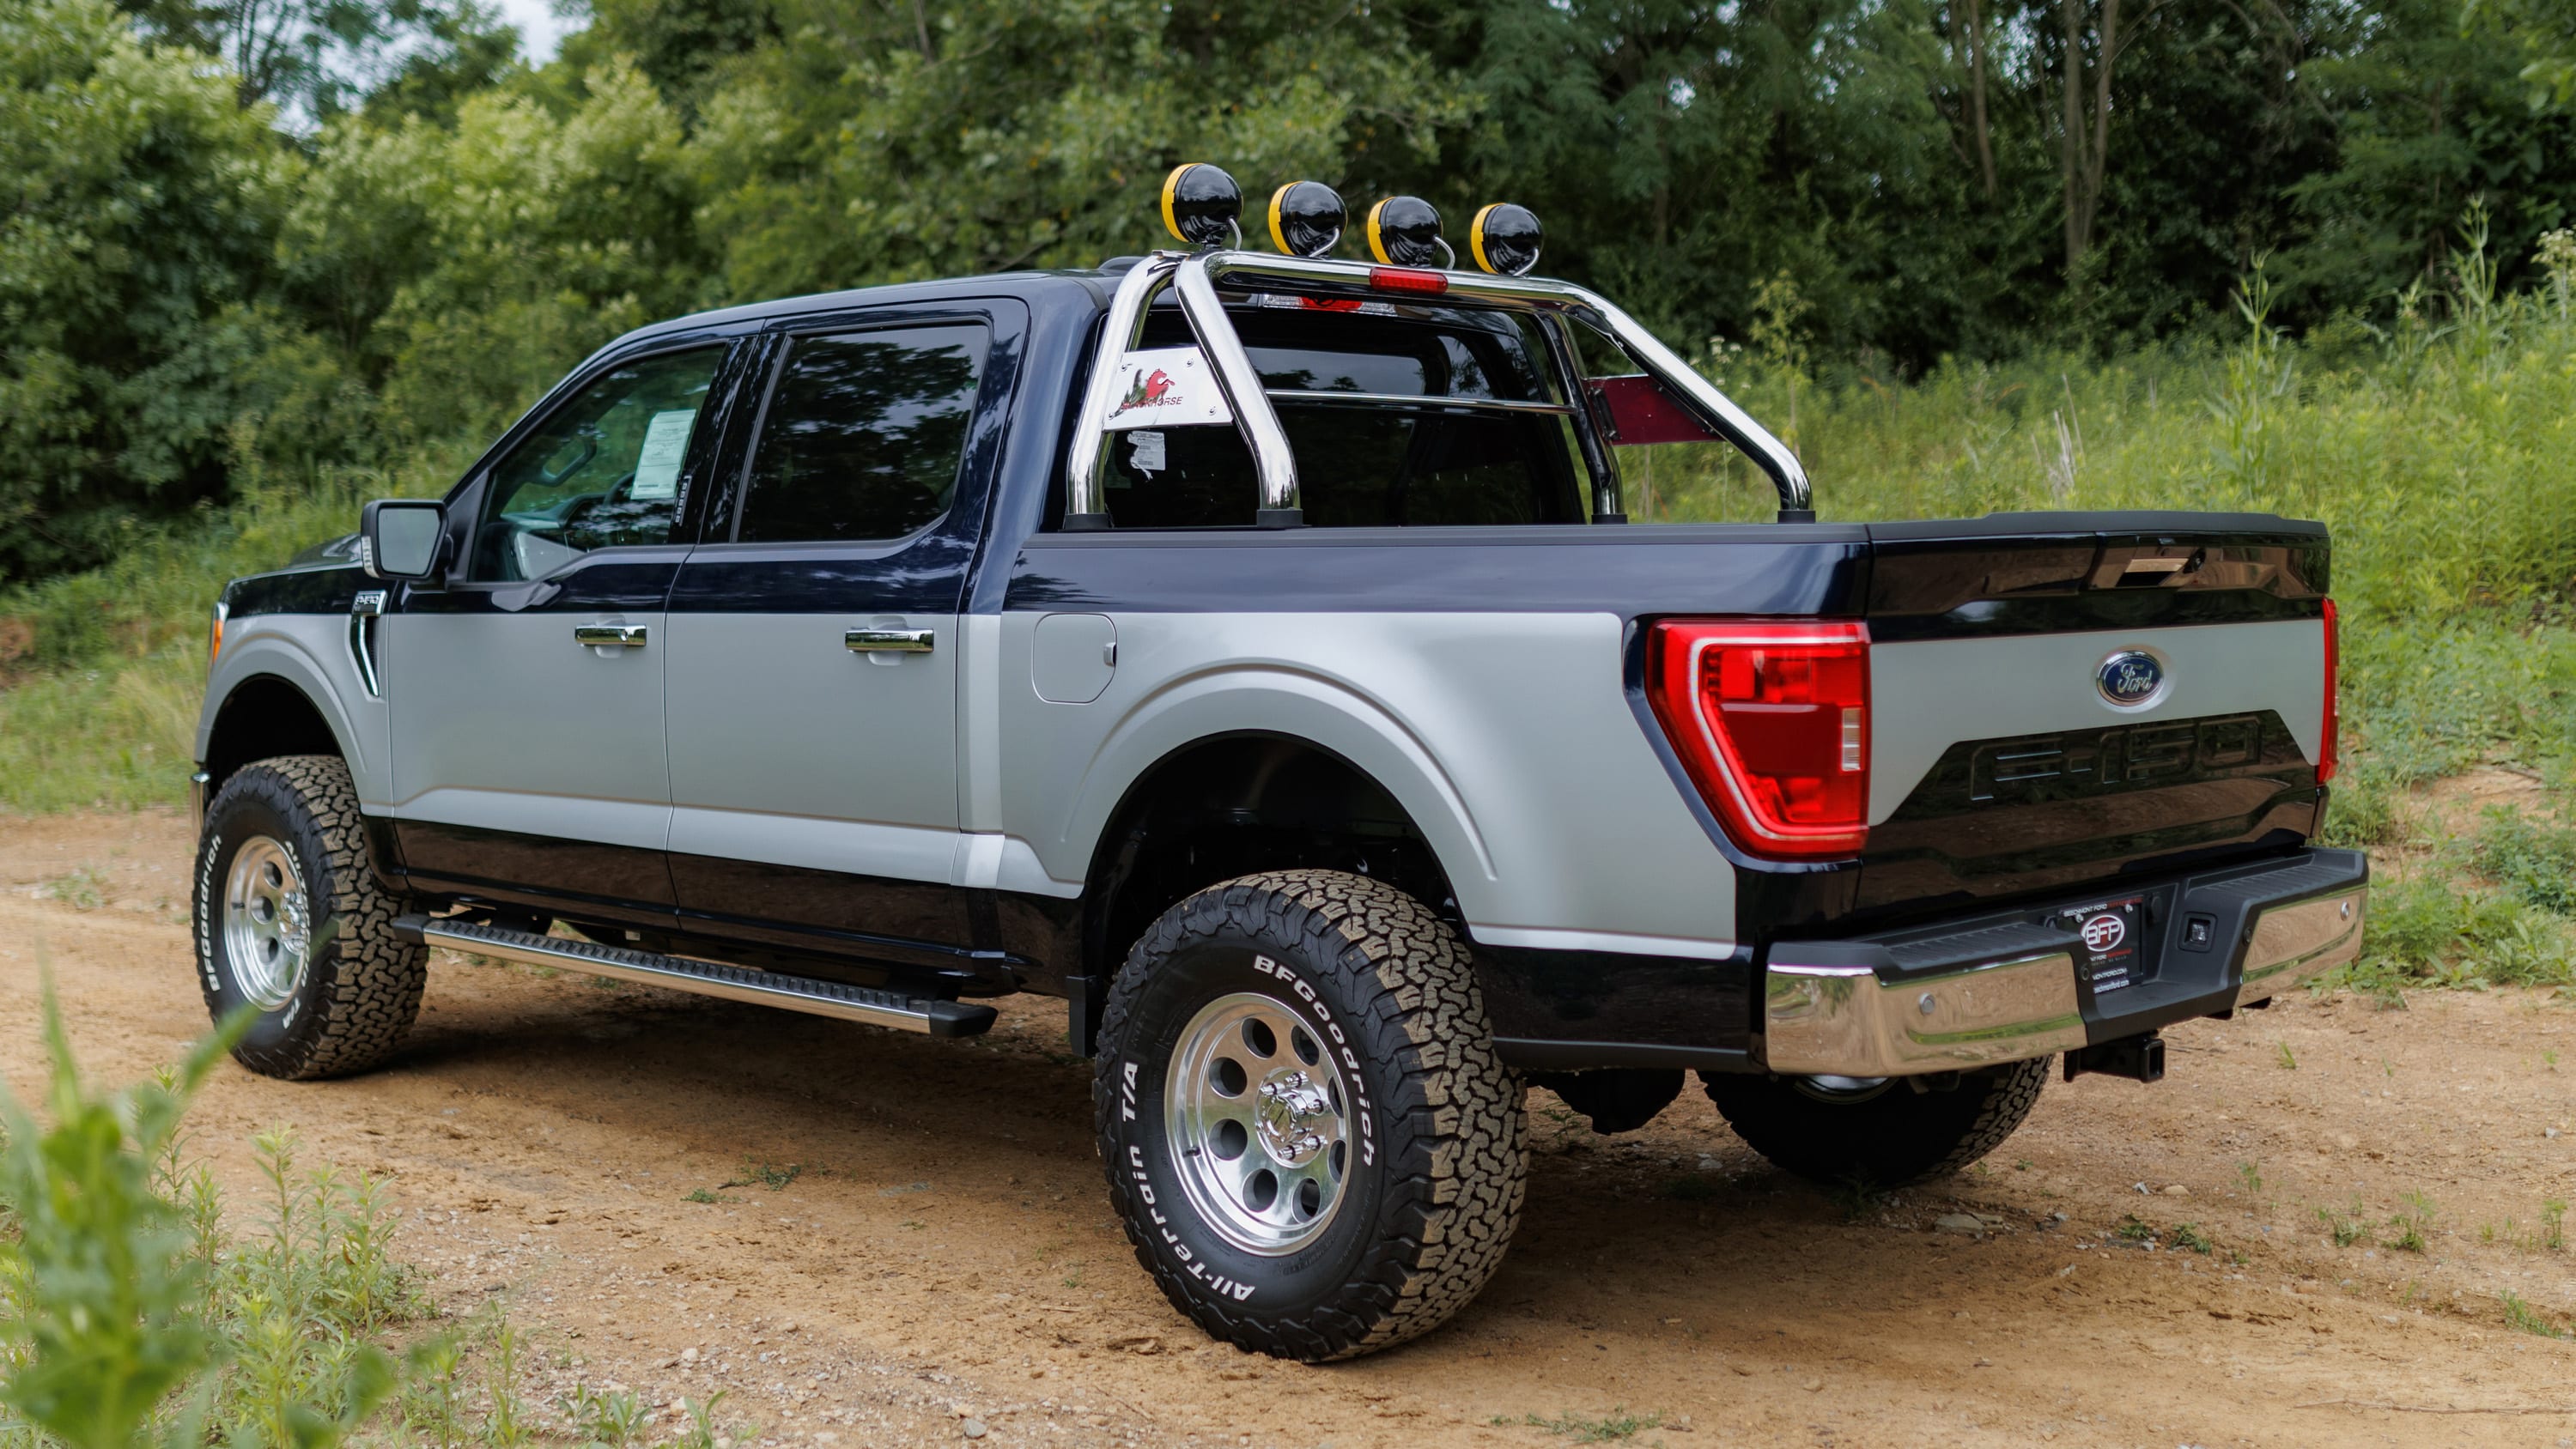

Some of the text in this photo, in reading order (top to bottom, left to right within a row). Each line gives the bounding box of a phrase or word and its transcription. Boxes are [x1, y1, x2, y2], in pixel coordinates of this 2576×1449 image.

[2116, 663, 2154, 694] Ford
[199, 834, 222, 991] BFGoodrich
[2087, 921, 2121, 945] BFP
[1254, 954, 1375, 1167] BFGoodrich
[1121, 1062, 1256, 1301] All-Terrain T/A
